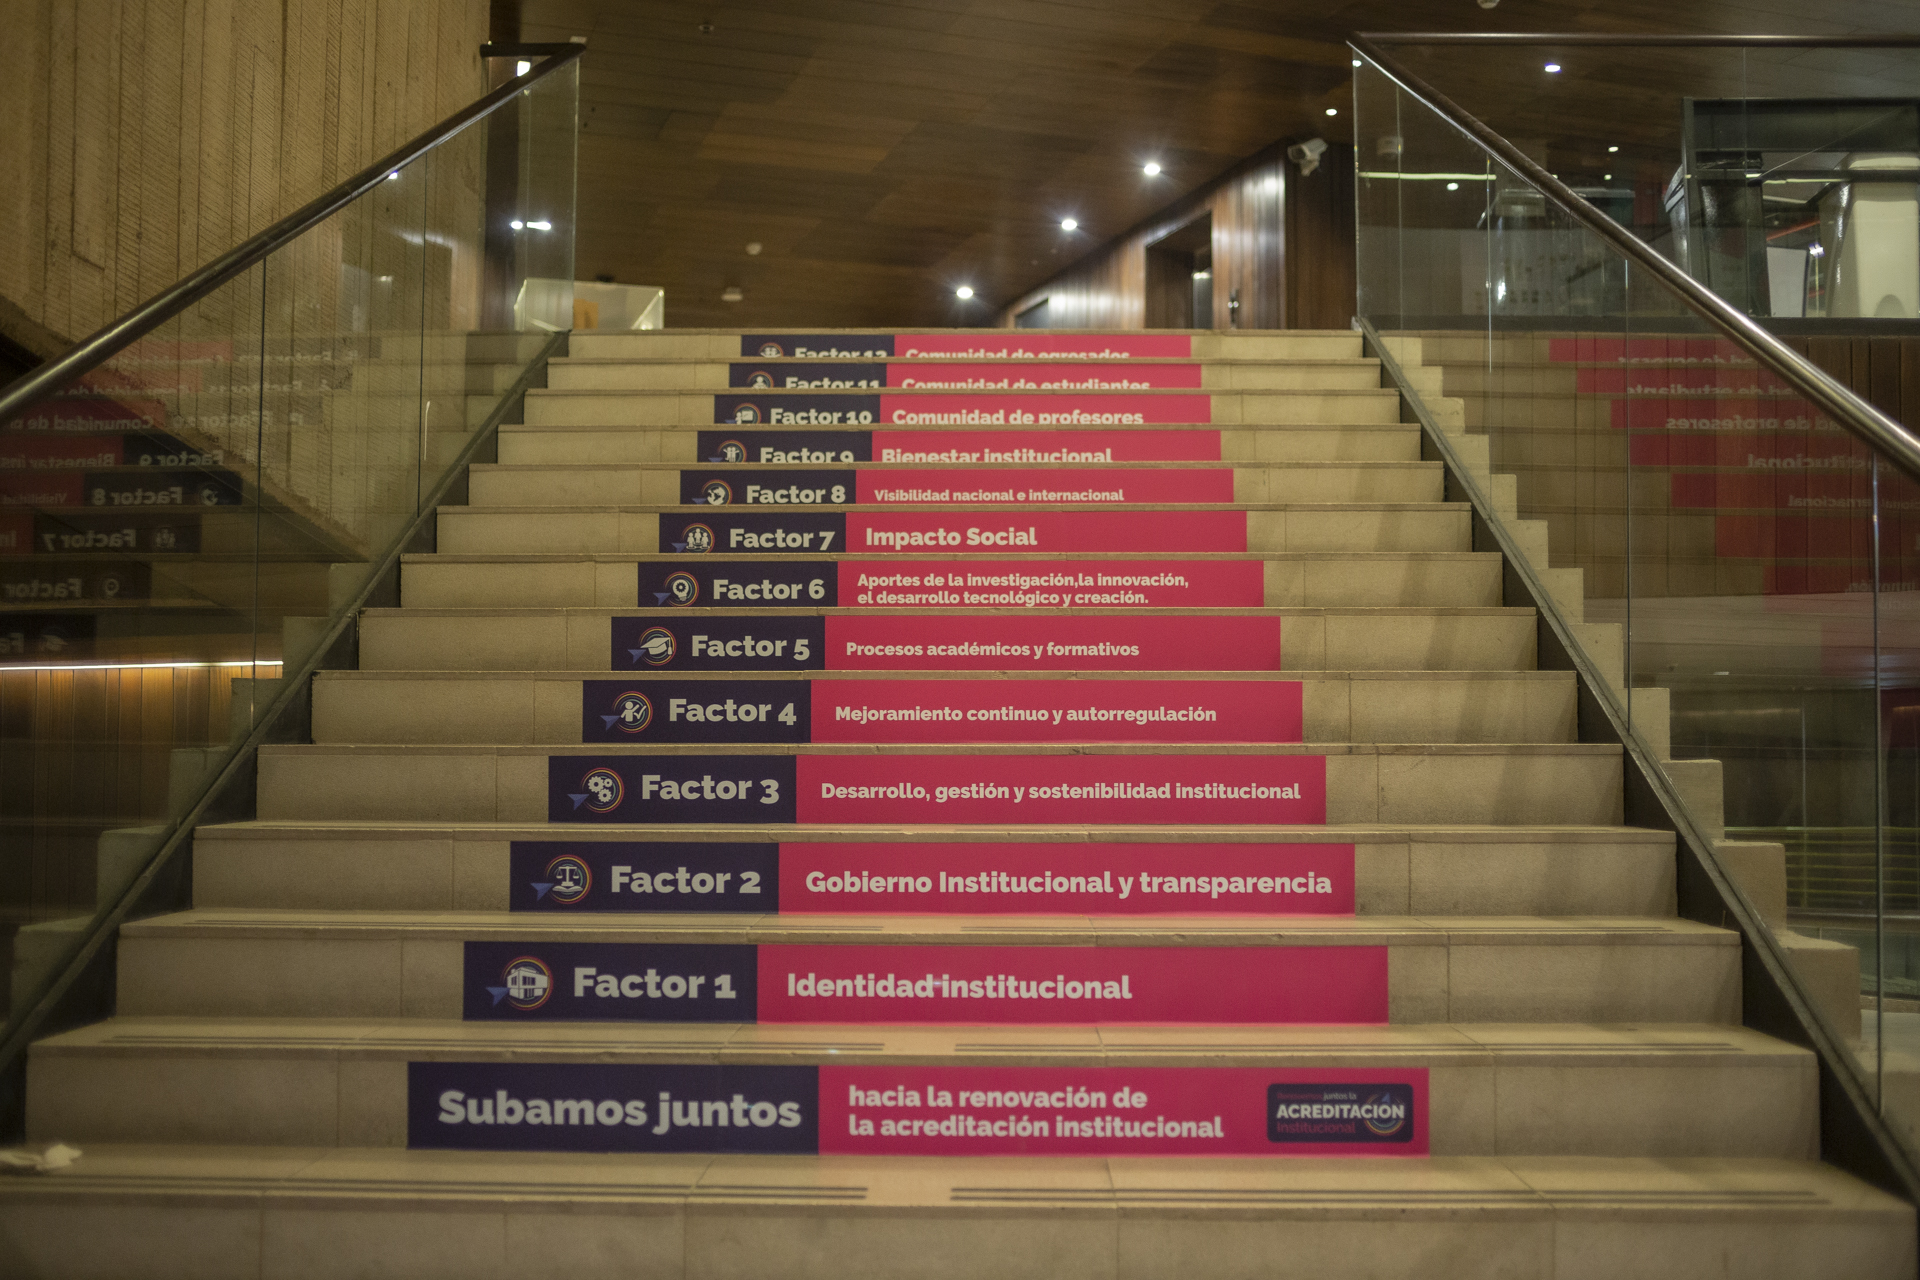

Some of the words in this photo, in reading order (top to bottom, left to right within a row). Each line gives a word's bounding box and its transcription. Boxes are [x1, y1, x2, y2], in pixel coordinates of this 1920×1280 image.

[785, 376, 855, 389] Factor
[900, 378, 1010, 389] Comunidad
[1012, 378, 1038, 389] de
[1040, 378, 1151, 389] estudiantes
[770, 407, 843, 425] Factor
[846, 410, 873, 425] 10
[892, 408, 1005, 425] Comunidad
[1008, 408, 1035, 425] de
[1038, 408, 1145, 425] profesores
[760, 447, 836, 463] Factor
[840, 450, 855, 463] 9
[881, 448, 981, 462] Bienestar
[983, 447, 1112, 462] institucional
[746, 485, 827, 503] Factor
[830, 484, 846, 503] 8
[873, 488, 951, 502] Visibilidad
[953, 488, 1015, 502] nacional
[1017, 491, 1027, 502] e
[1029, 488, 1125, 502] internacional
[729, 528, 815, 548] Factor
[818, 531, 836, 551] 7
[866, 527, 962, 551] Impacto
[966, 526, 1038, 546] Social
[713, 578, 803, 600] Factor
[808, 578, 826, 600] 6
[857, 573, 921, 589] Aportes
[923, 573, 945, 587] de
[948, 573, 964, 587] la
[1097, 573, 1190, 588] innovación,
[857, 590, 874, 604] el
[876, 591, 961, 604] desarrollo
[962, 590, 1060, 607] tecnológico
[1062, 593, 1072, 607] y
[1074, 591, 1149, 604] creación.
[691, 634, 788, 658] Factor
[793, 638, 811, 661] 5
[846, 641, 924, 656] Procesos
[926, 641, 1031, 657] académicos
[1033, 645, 1044, 660] y
[1046, 641, 1140, 657] formativos
[669, 698, 772, 723] Factor
[777, 702, 797, 726] 4
[835, 705, 964, 725] Mejoramiento
[966, 705, 1050, 722] continuo
[1051, 709, 1064, 726] y
[1066, 705, 1217, 726] autorregulación
[641, 774, 753, 801] Factor
[759, 778, 780, 805] 3
[821, 782, 932, 803] Desarrollo,
[934, 782, 1010, 804] gestión
[1013, 786, 1026, 804] y
[1028, 782, 1172, 800] sostenibilidad
[1175, 782, 1302, 801] institucional
[611, 865, 732, 894] Factor
[738, 870, 761, 894] 2
[805, 870, 933, 893] Gobierno
[939, 870, 1114, 894] Institucional
[1117, 876, 1135, 900] y
[1138, 871, 1333, 899] transparencia
[574, 967, 706, 999] Factor
[714, 974, 737, 999] 1
[787, 972, 935, 998] Identidad
[940, 973, 1133, 1000] institucional
[848, 1084, 922, 1108] hacia
[926, 1085, 954, 1108] la
[958, 1085, 1107, 1109] renovación
[1112, 1085, 1148, 1109] de
[1323, 1092, 1348, 1102] juntos
[438, 1090, 648, 1126] Subamos
[652, 1091, 802, 1135] juntos
[848, 1113, 875, 1136] la
[880, 1114, 1050, 1137] acreditación
[1055, 1115, 1225, 1139] institucional
[1276, 1122, 1356, 1134] Institucional
